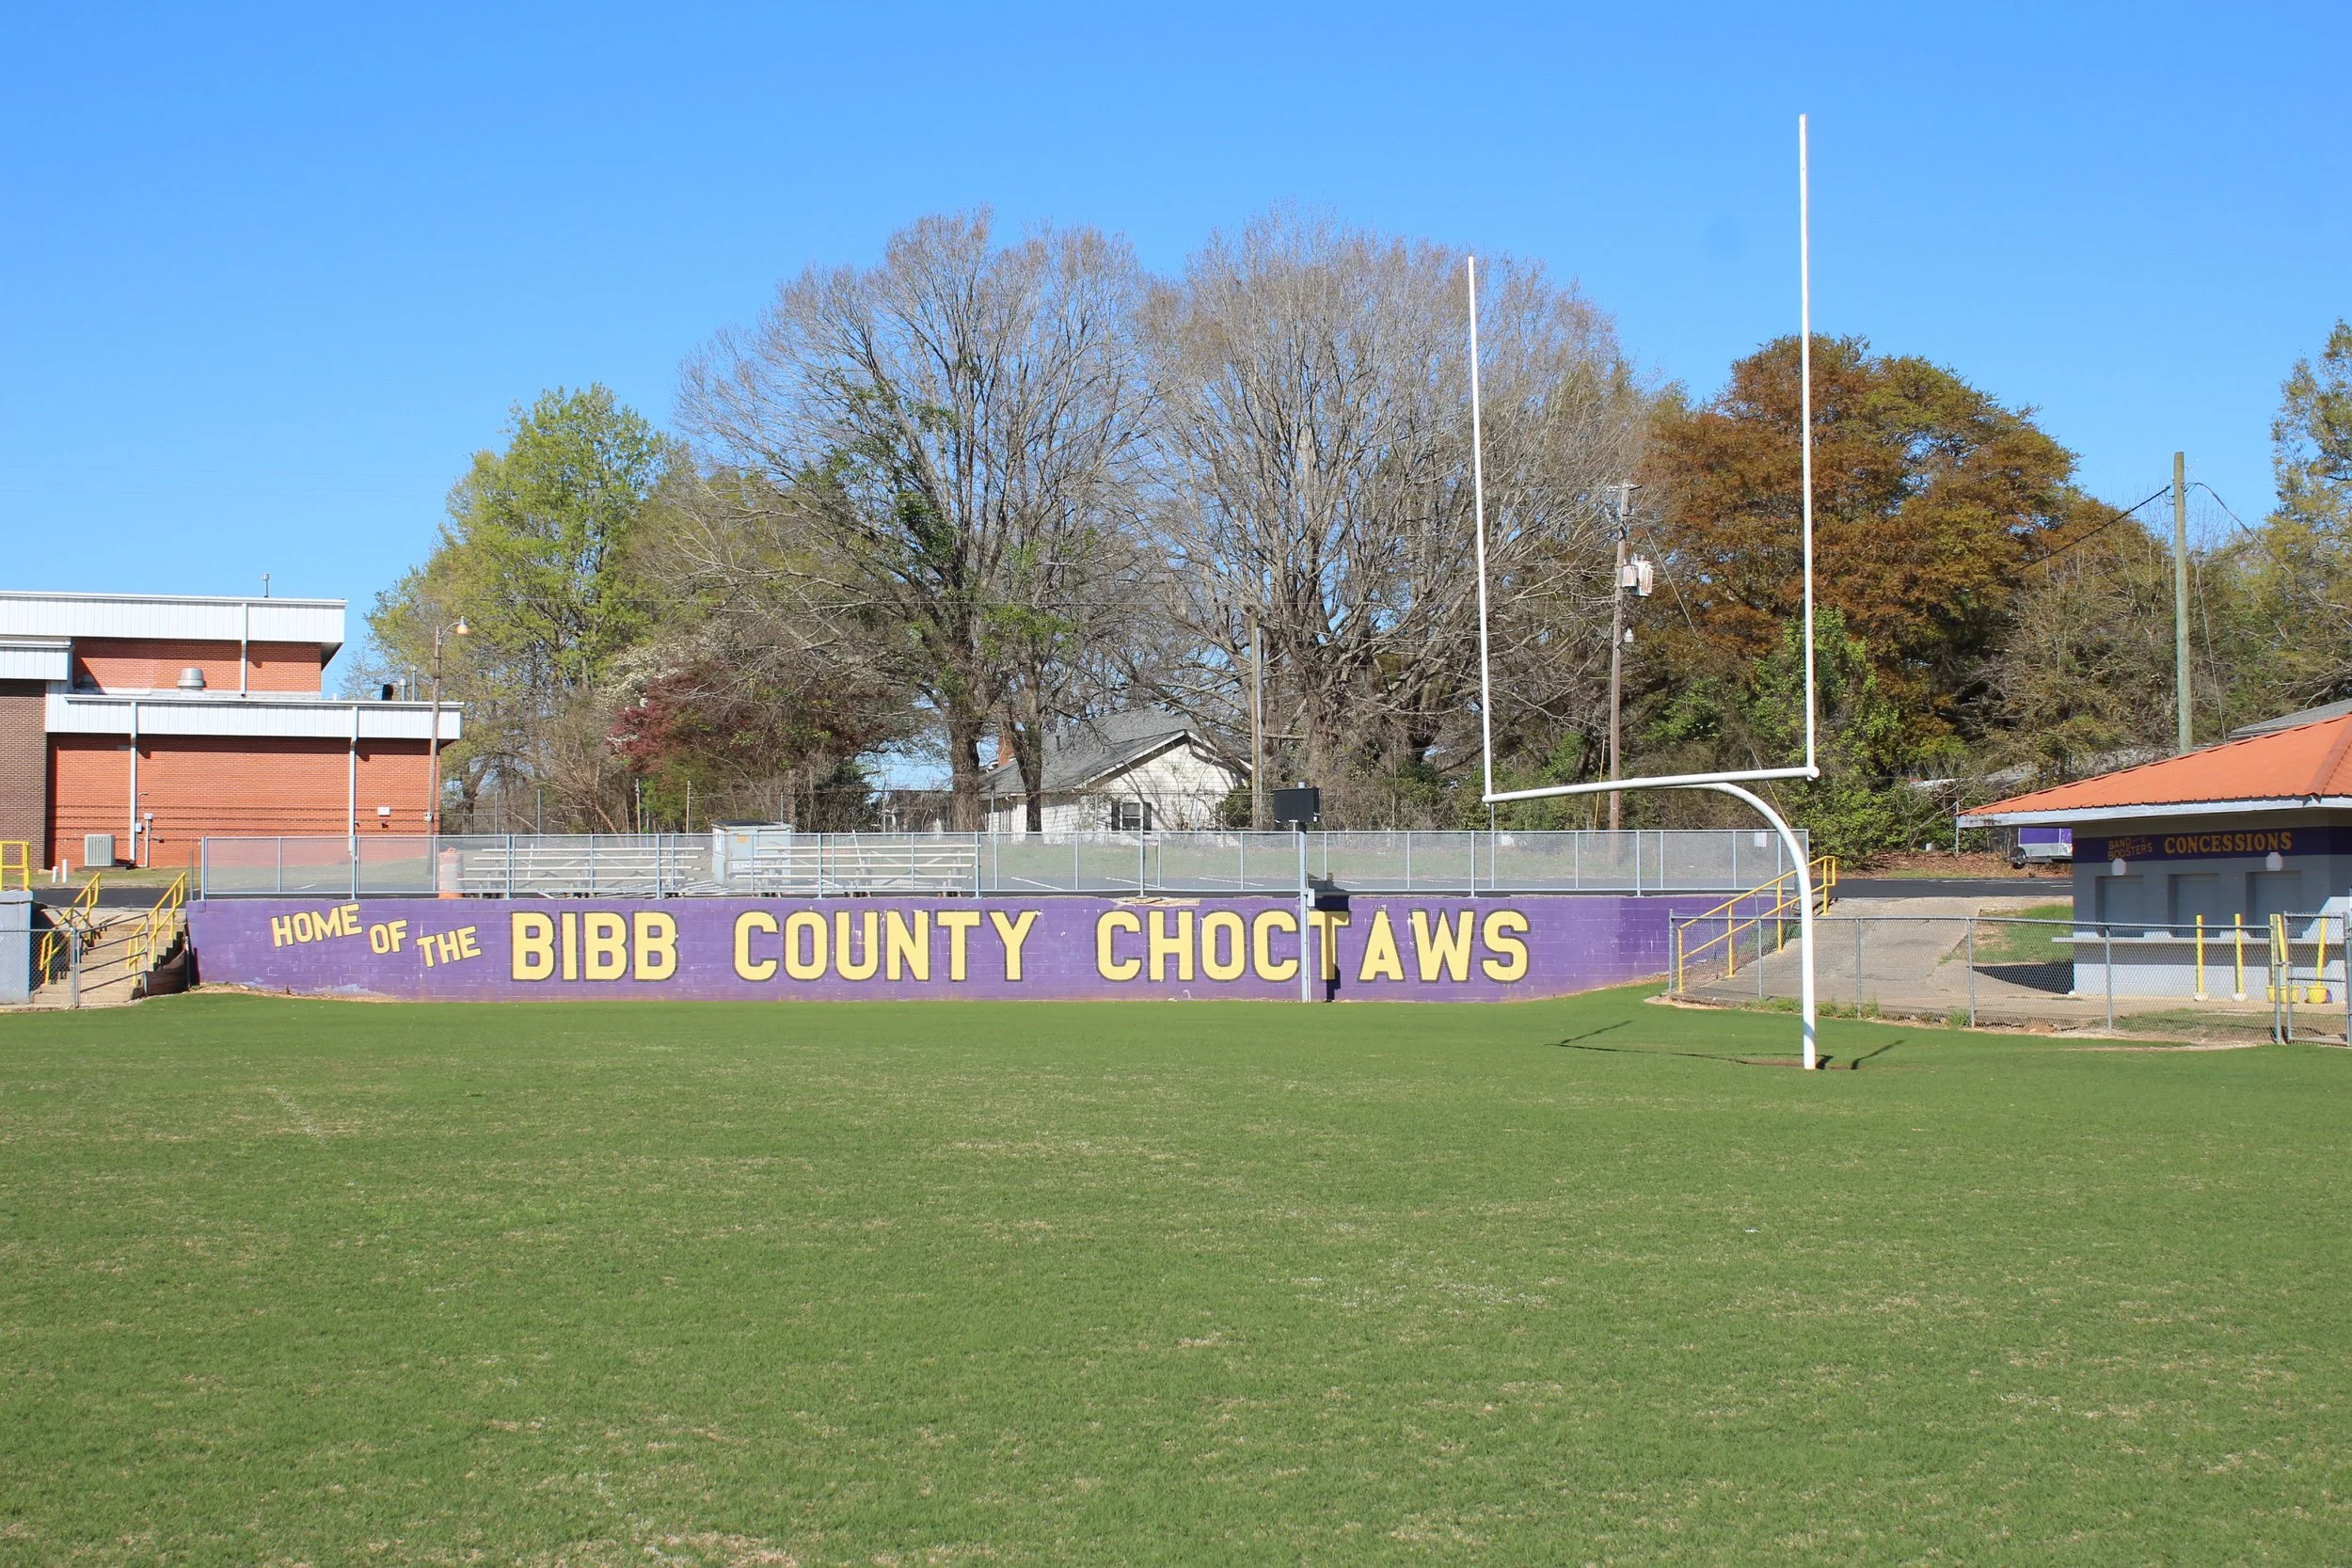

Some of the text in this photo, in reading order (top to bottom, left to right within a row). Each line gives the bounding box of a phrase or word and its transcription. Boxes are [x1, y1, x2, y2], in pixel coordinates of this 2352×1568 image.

[2107, 836, 2132, 850] BAND
[2107, 842, 2153, 861] BOOSTERS
[2164, 832, 2293, 854] CONCESSIONS
[271, 903, 482, 968] HOME OF THE
[511, 910, 1531, 982] BIBB COUNTY CHOCTAWS
